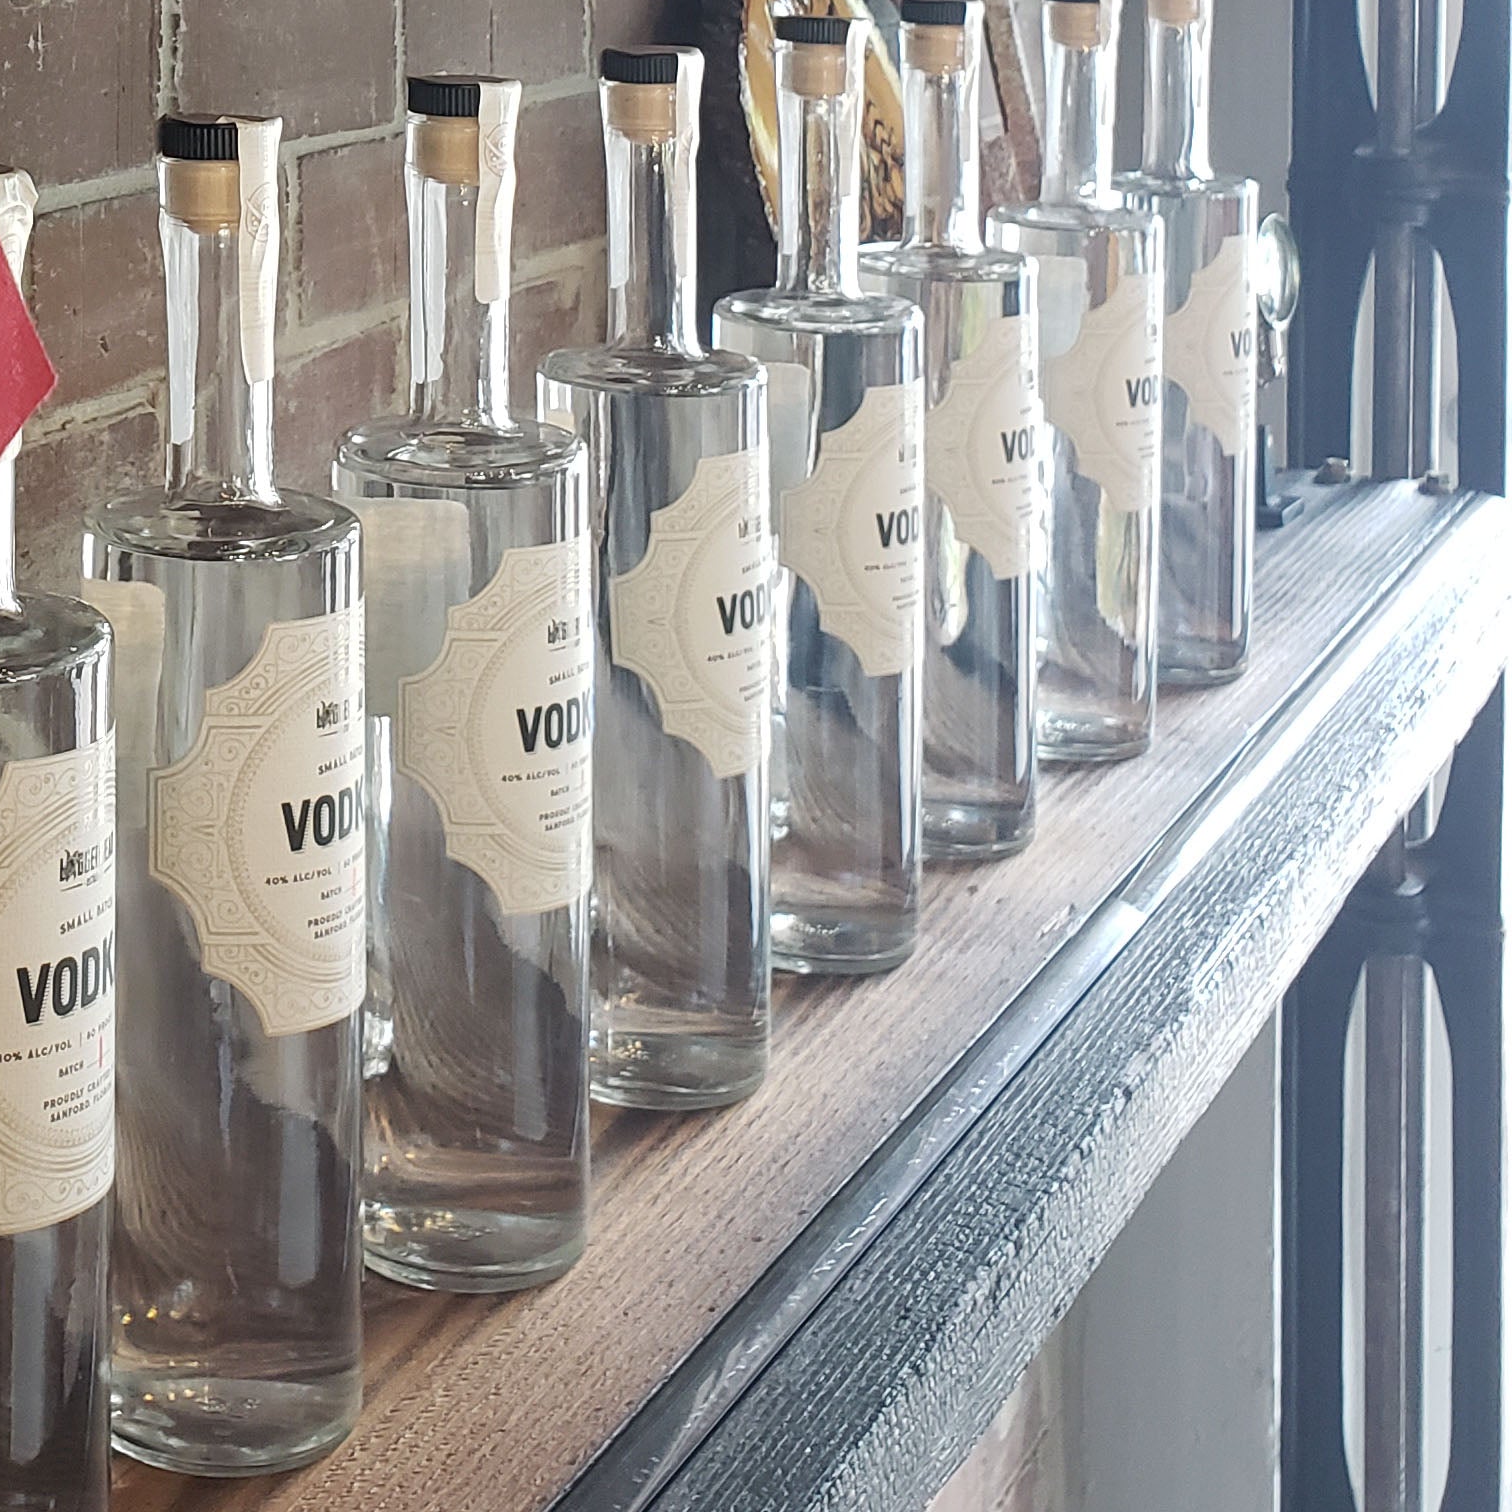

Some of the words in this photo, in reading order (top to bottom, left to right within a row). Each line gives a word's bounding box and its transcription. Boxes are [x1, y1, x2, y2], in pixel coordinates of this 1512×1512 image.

[318, 755, 348, 776] SMALL
[281, 773, 365, 852] VODK
[265, 876, 288, 886] 40%
[293, 867, 332, 883] ALC/VOL
[60, 908, 93, 935] SMALL
[16, 931, 113, 1024] VODK
[28, 1039, 72, 1059] ALC/VOL
[58, 1060, 84, 1078] BATCH
[43, 1087, 84, 1110] PROUDLY
